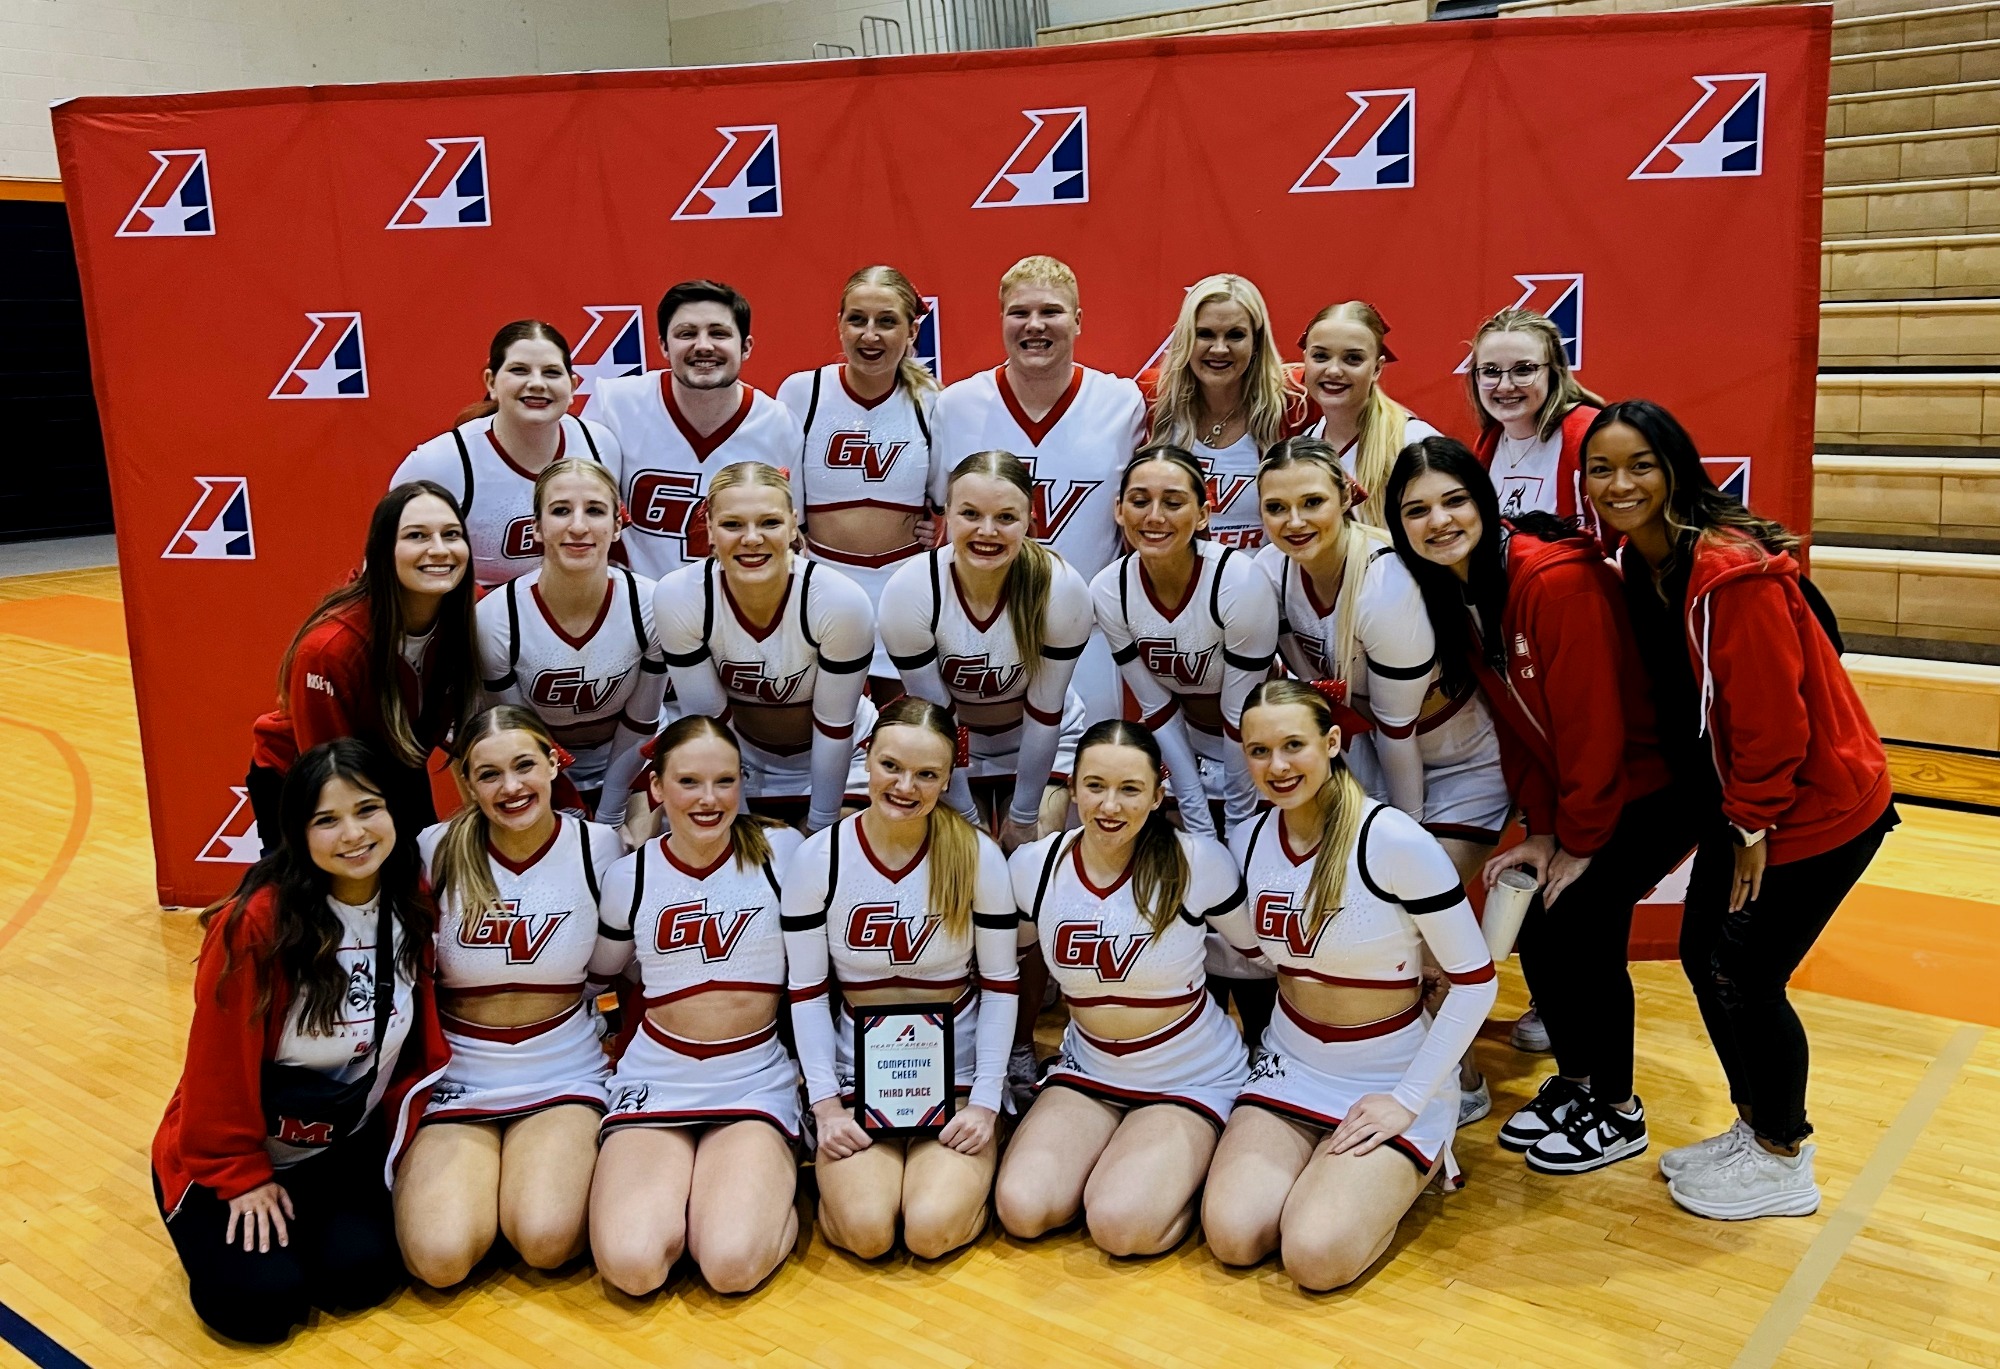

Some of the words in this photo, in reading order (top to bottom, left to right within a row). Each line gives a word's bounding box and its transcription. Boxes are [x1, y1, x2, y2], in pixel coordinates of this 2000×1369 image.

[824, 430, 909, 482] GV
[1018, 456, 1104, 544] V
[1197, 456, 1256, 515] V
[719, 660, 812, 704] GV
[941, 653, 1027, 699] GV
[1136, 637, 1219, 686] GV
[530, 666, 631, 715] GV
[457, 899, 573, 965] GV
[654, 898, 765, 964] GV
[845, 901, 945, 965] GV
[1254, 891, 1345, 958] GV
[1053, 919, 1155, 982] GV
[877, 1058, 931, 1070] COMPETITIVE
[891, 1070, 918, 1080] CHEER
[878, 1088, 903, 1098] THIRD
[905, 1087, 931, 1098] PLACE
[896, 1108, 915, 1116] 2024
